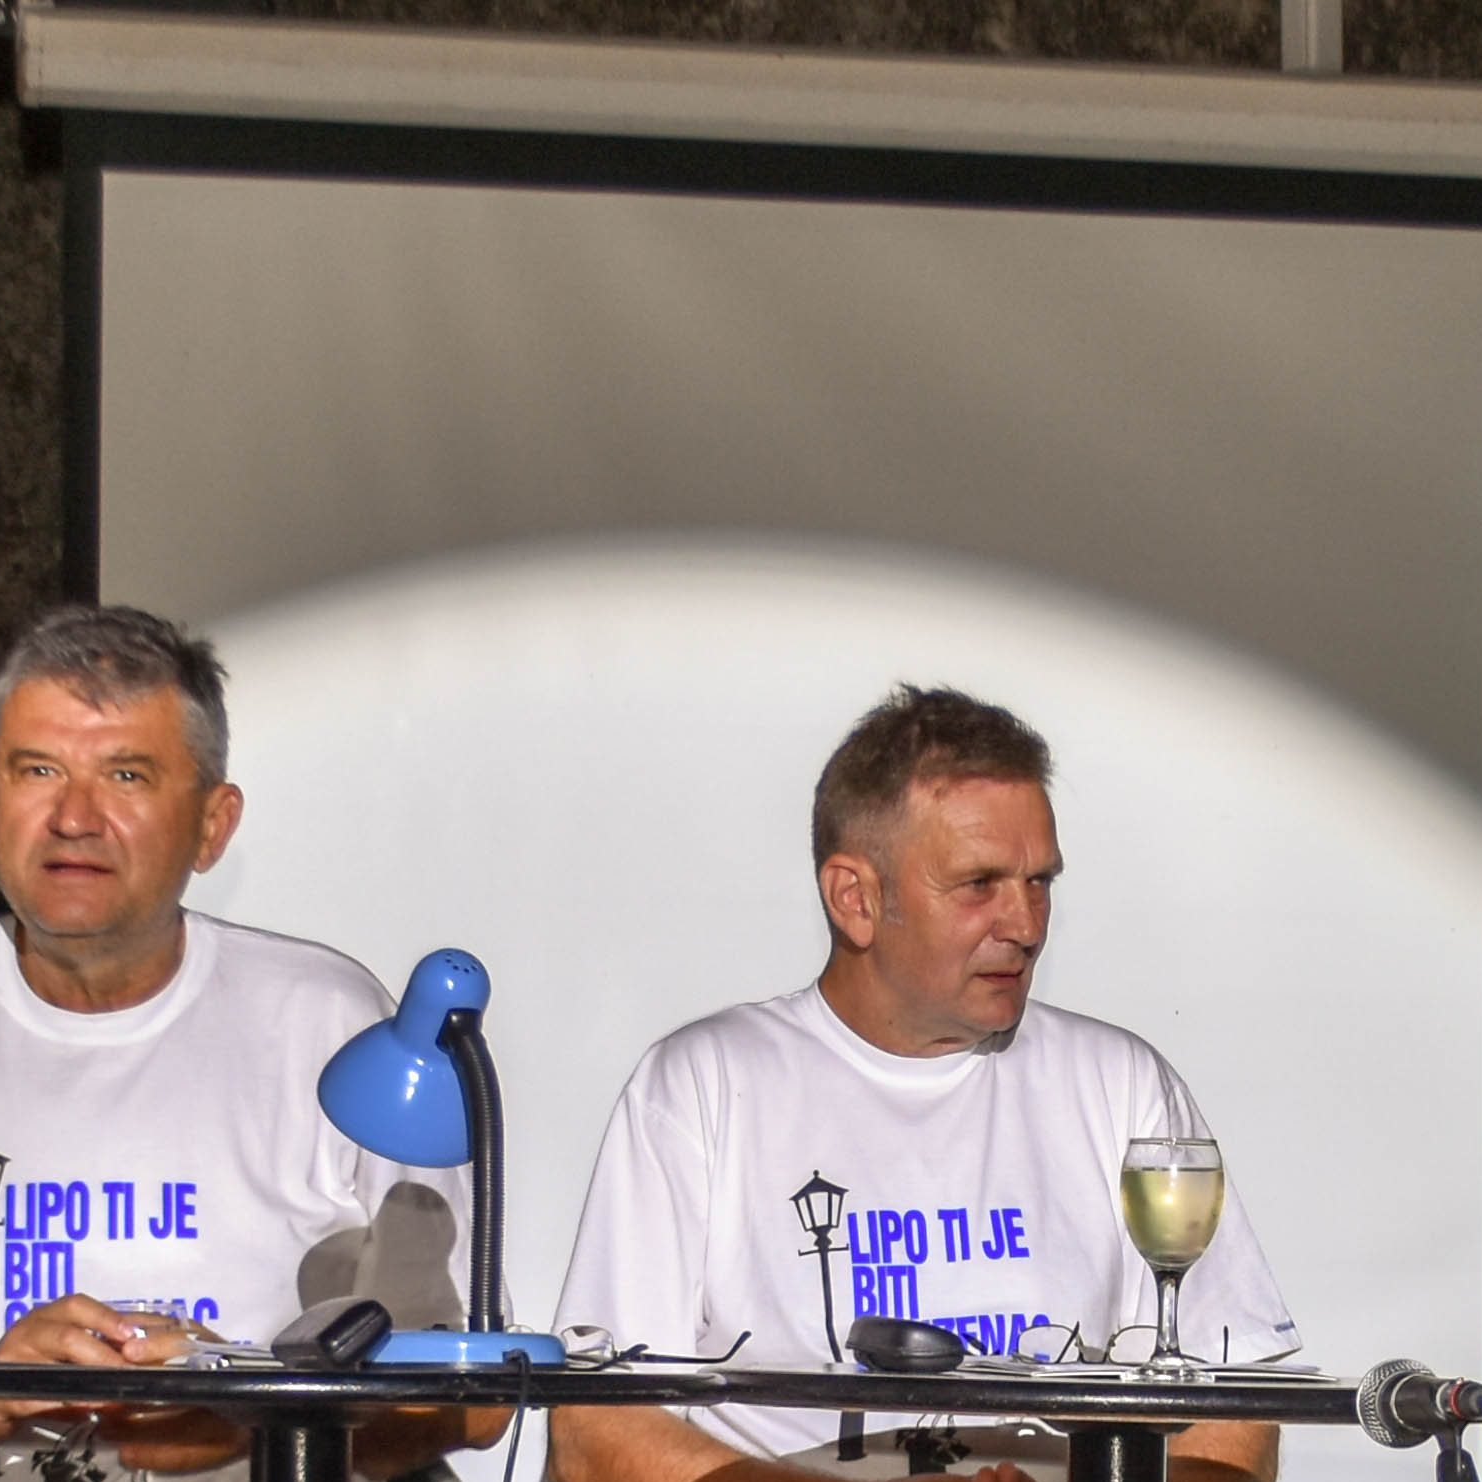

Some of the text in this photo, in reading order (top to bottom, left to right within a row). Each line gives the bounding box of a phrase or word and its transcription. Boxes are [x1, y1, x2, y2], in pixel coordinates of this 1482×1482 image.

[5, 1180, 199, 1241] LIPO TI JE
[847, 1207, 1030, 1265] LIPO TI JE
[5, 1242, 75, 1300] BITI
[851, 1264, 920, 1323] BITI
